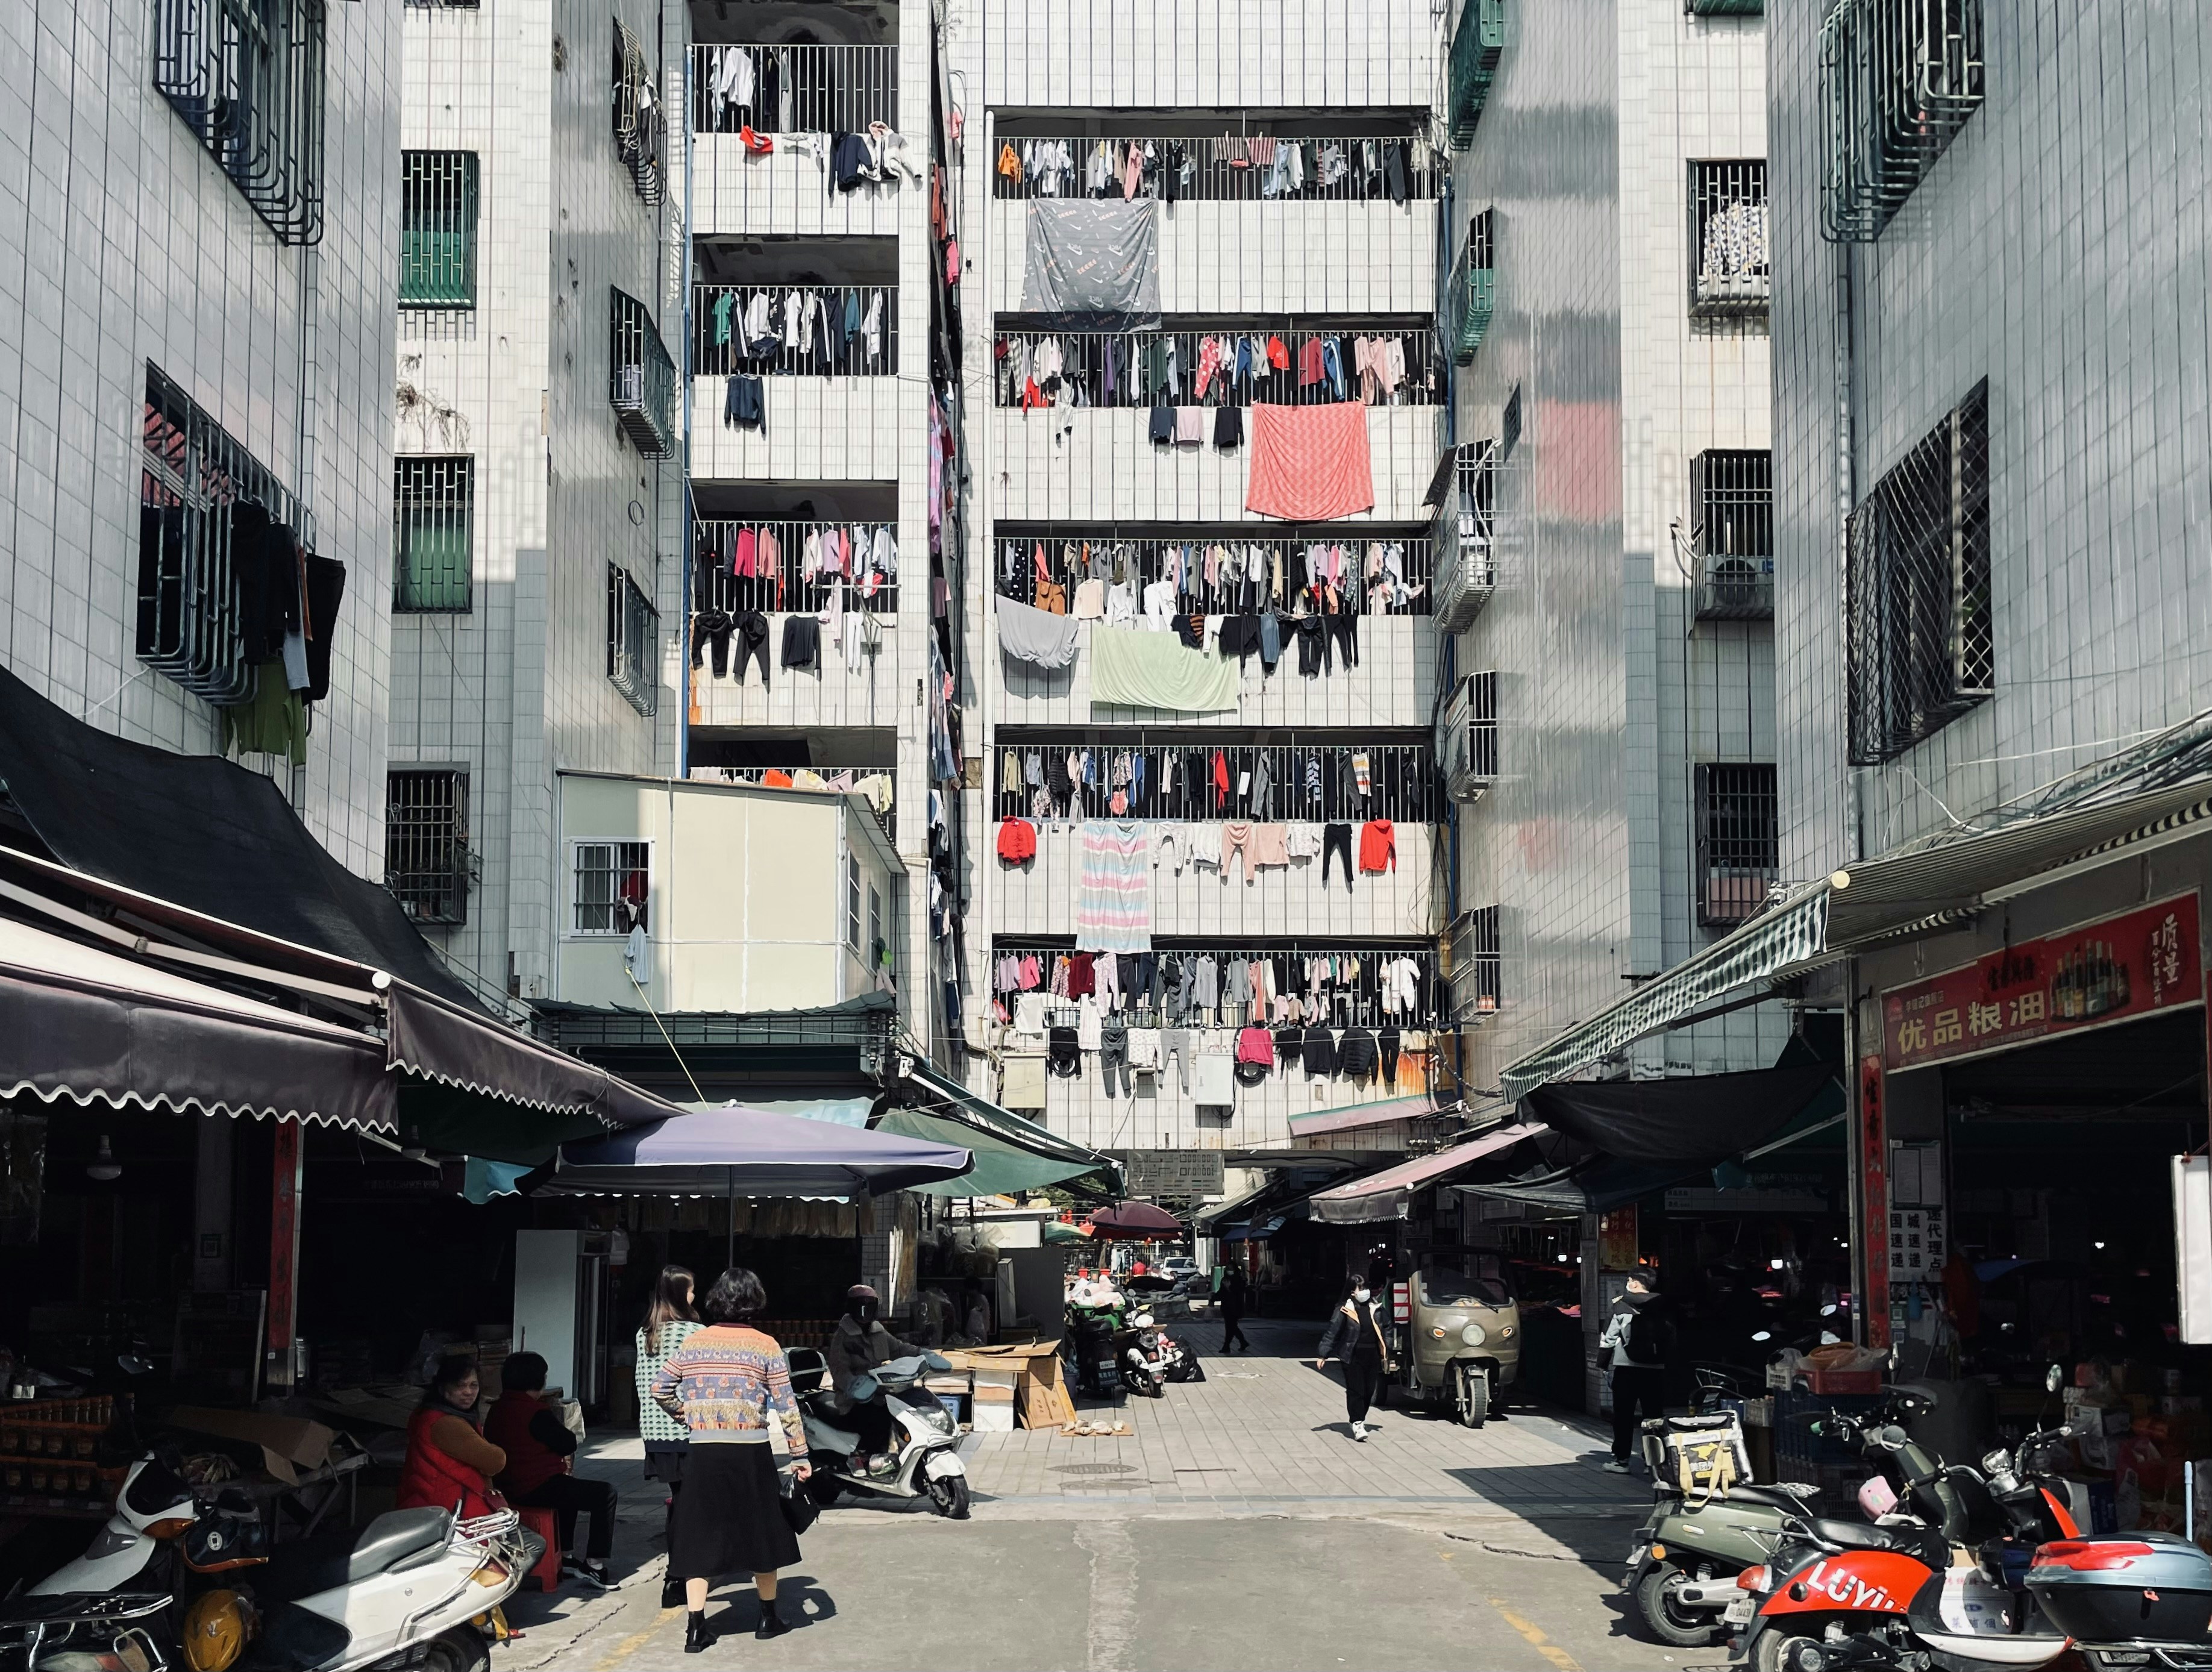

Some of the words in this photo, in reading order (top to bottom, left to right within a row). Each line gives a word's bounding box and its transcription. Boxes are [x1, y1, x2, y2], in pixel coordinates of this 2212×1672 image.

[2163, 913, 2180, 985] 质量
[1897, 989, 2045, 1055] 优品粮油
[1890, 1213, 1903, 1268] 国速递
[1908, 1213, 1921, 1268] 城速递
